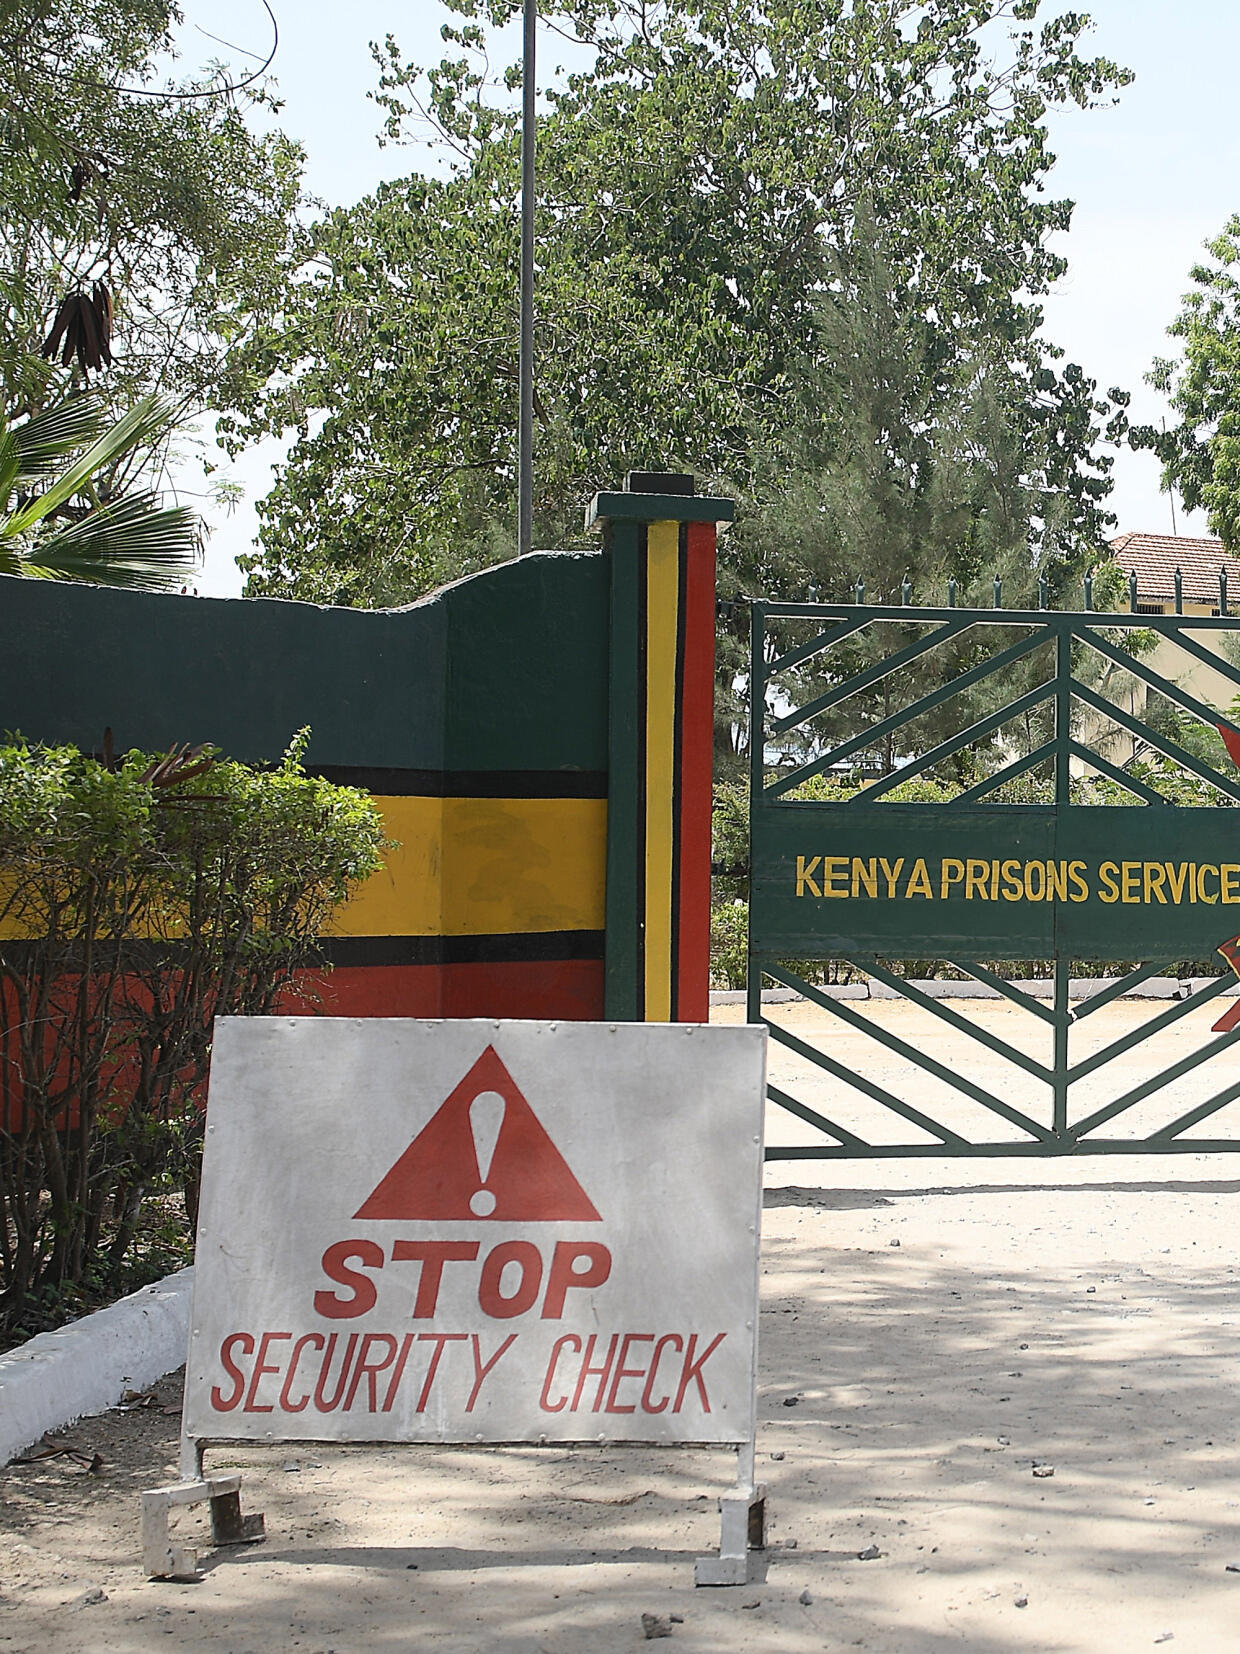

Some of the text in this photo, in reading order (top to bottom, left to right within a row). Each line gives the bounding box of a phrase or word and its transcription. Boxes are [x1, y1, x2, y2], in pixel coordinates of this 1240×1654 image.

[796, 855, 933, 899] KENYA
[939, 858, 1088, 902] PRISONS
[313, 1239, 613, 1320] STOP
[210, 1332, 728, 1414] SECURITY CHECK
